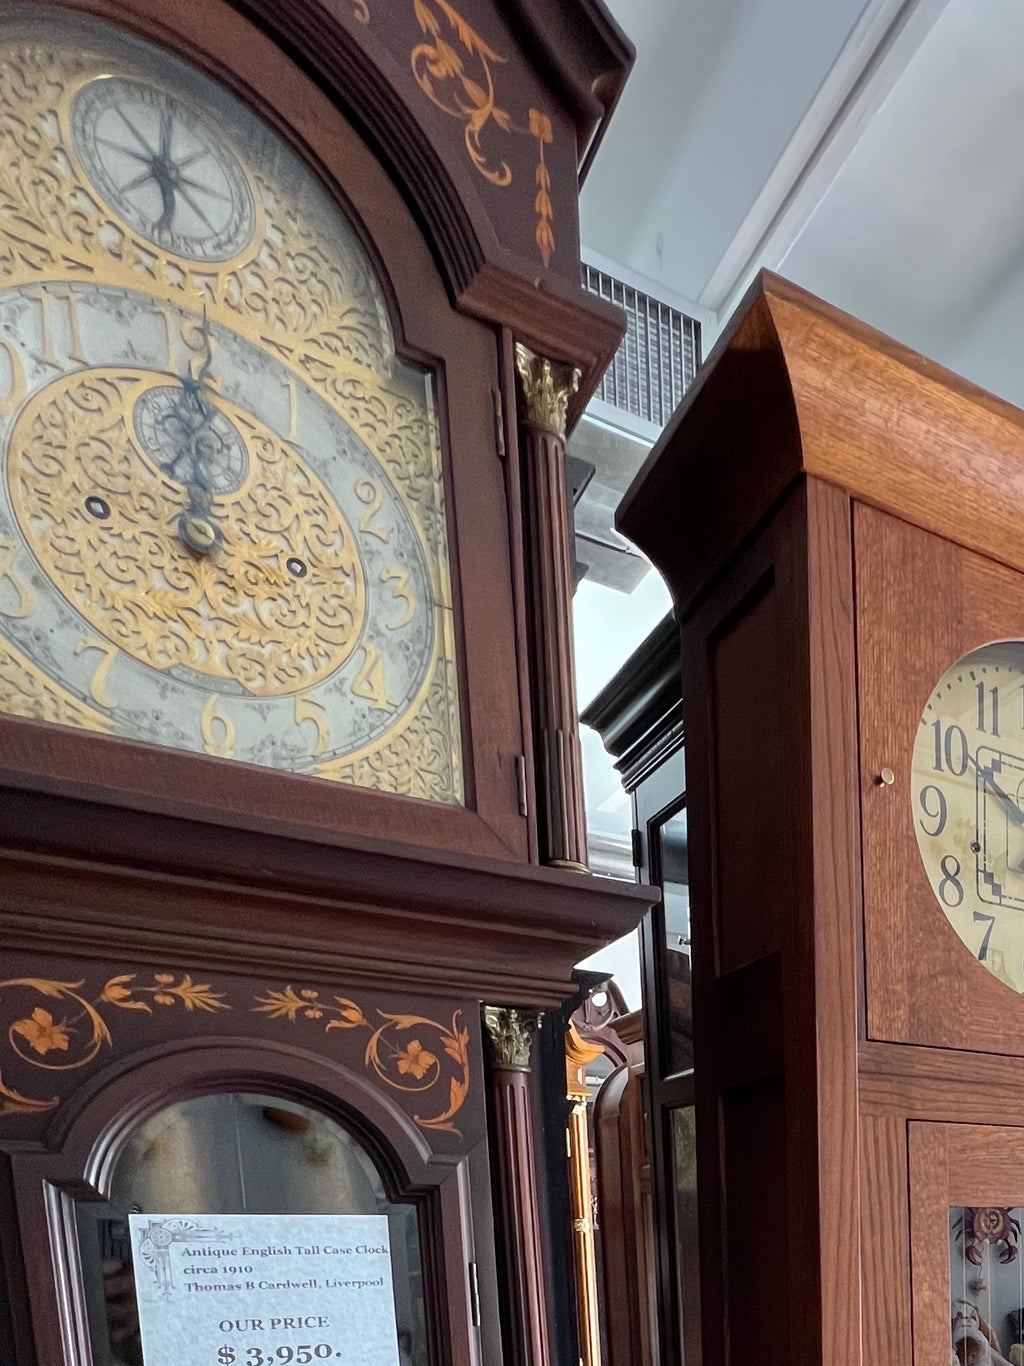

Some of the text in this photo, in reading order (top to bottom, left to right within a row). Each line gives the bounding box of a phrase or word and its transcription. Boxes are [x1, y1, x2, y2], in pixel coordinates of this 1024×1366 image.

[354, 477, 392, 543] 2
[380, 565, 418, 630] 3
[74, 636, 119, 709] 7
[351, 642, 398, 718] 4
[201, 692, 235, 757] 6
[294, 692, 330, 756] 5
[975, 681, 1001, 738] 11
[931, 718, 969, 777] 10
[919, 785, 947, 836] 9
[939, 854, 964, 907] 8
[973, 910, 995, 961] 7
[181, 1244, 389, 1259] Antique English Tall Case Clock
[183, 1265, 254, 1275] circa 1910
[184, 1277, 384, 1292] Thomas B Cardwell, Liverpool
[218, 1316, 330, 1332] OUR PRICE
